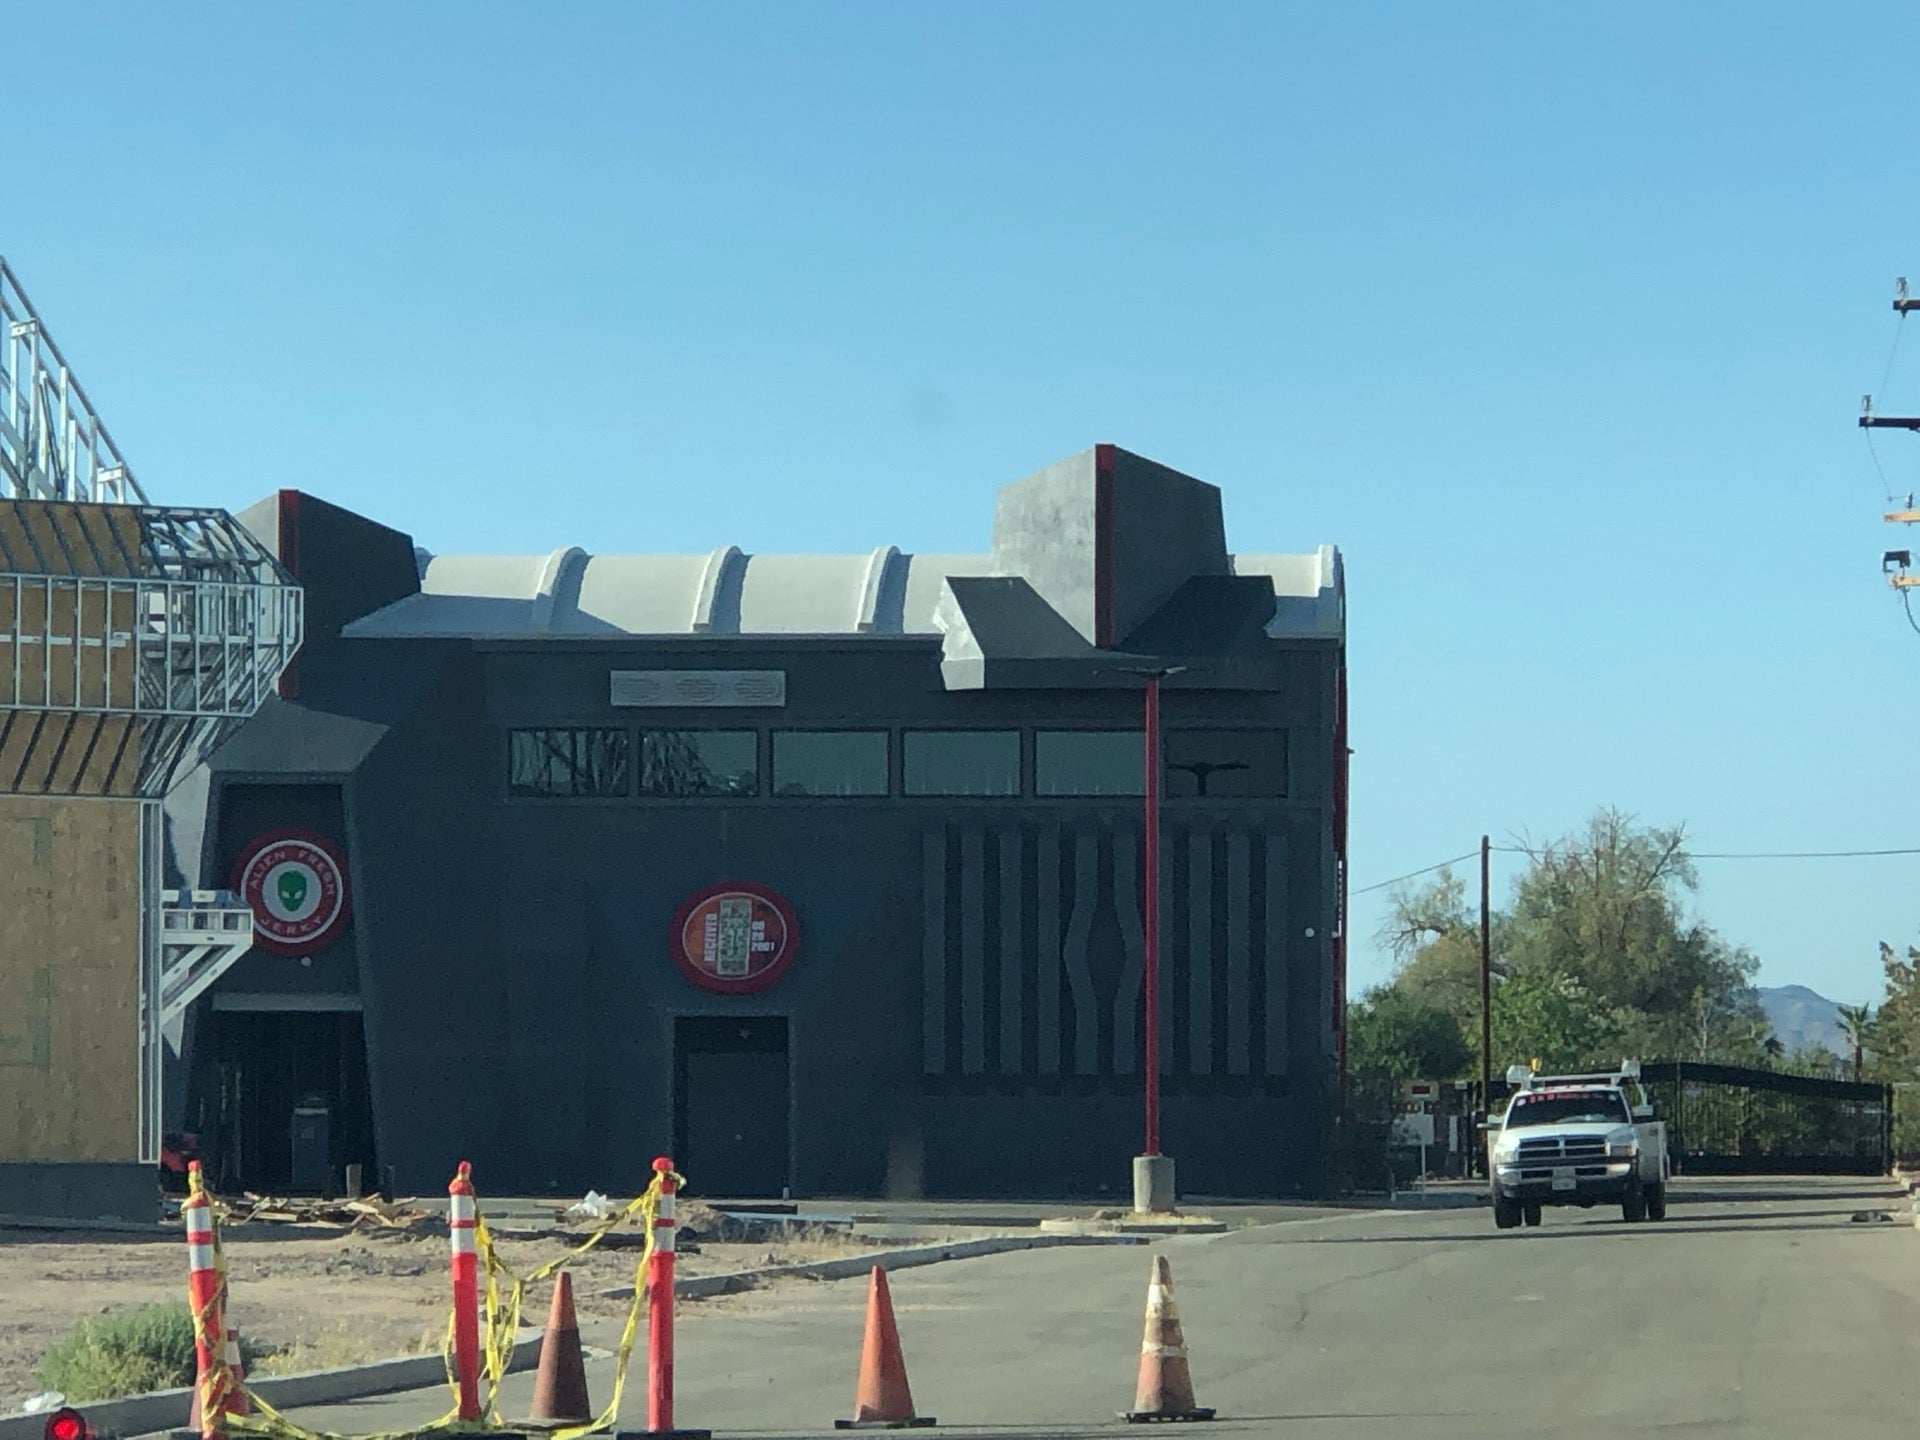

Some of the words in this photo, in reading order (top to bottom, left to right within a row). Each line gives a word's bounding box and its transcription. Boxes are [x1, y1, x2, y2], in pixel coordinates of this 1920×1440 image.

[249, 851, 286, 889] ALIEN
[298, 850, 335, 895] FRESH
[261, 916, 321, 934] JERKY
[703, 913, 718, 962] RECEIVED
